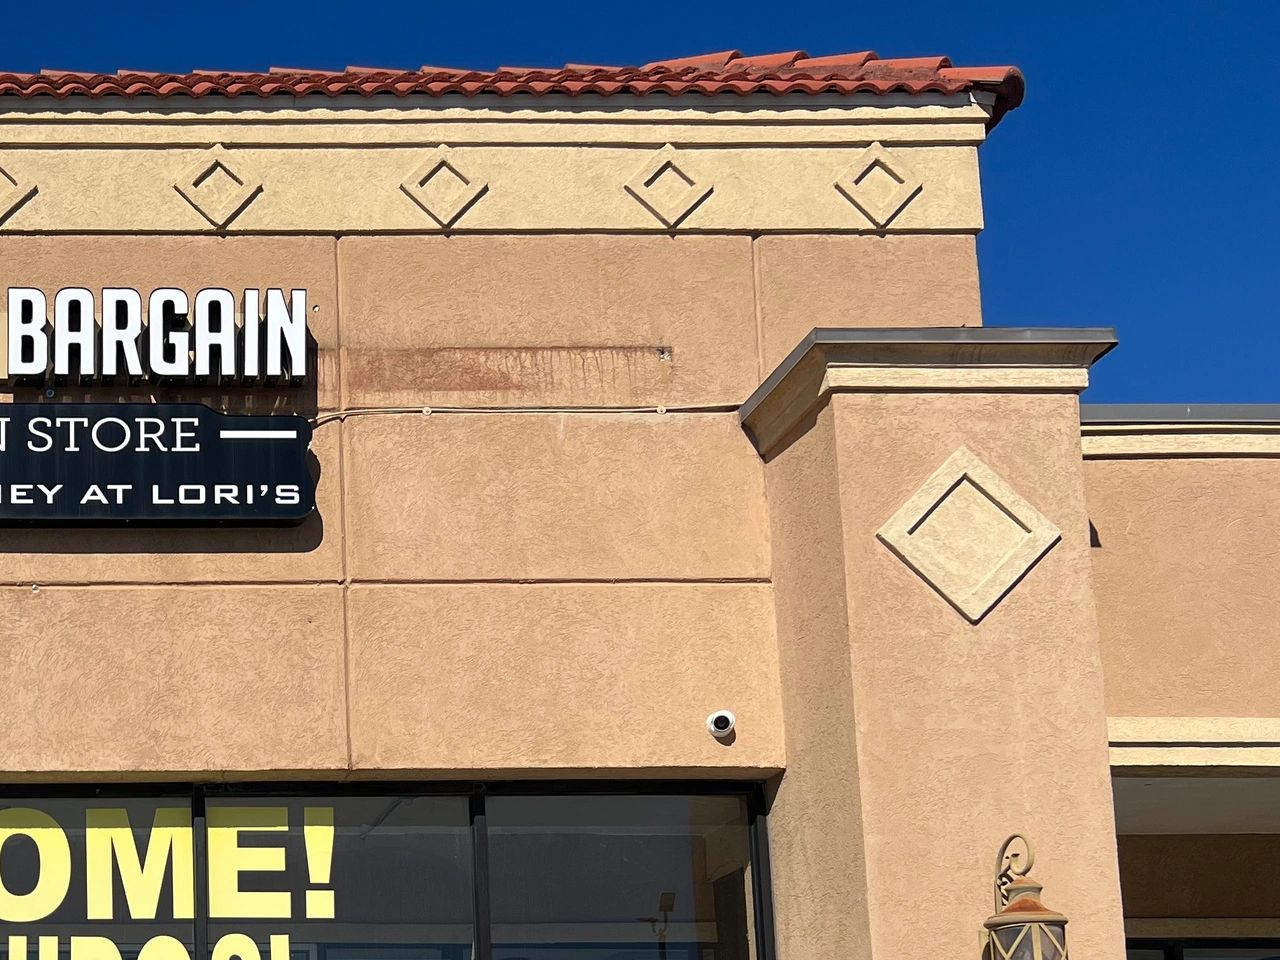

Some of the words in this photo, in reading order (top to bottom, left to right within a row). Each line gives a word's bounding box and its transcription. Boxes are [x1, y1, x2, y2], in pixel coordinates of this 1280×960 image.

[7, 287, 308, 376] BARGAIN
[26, 416, 200, 452] STORE
[80, 483, 132, 505] AT
[152, 483, 301, 505] LORI'S
